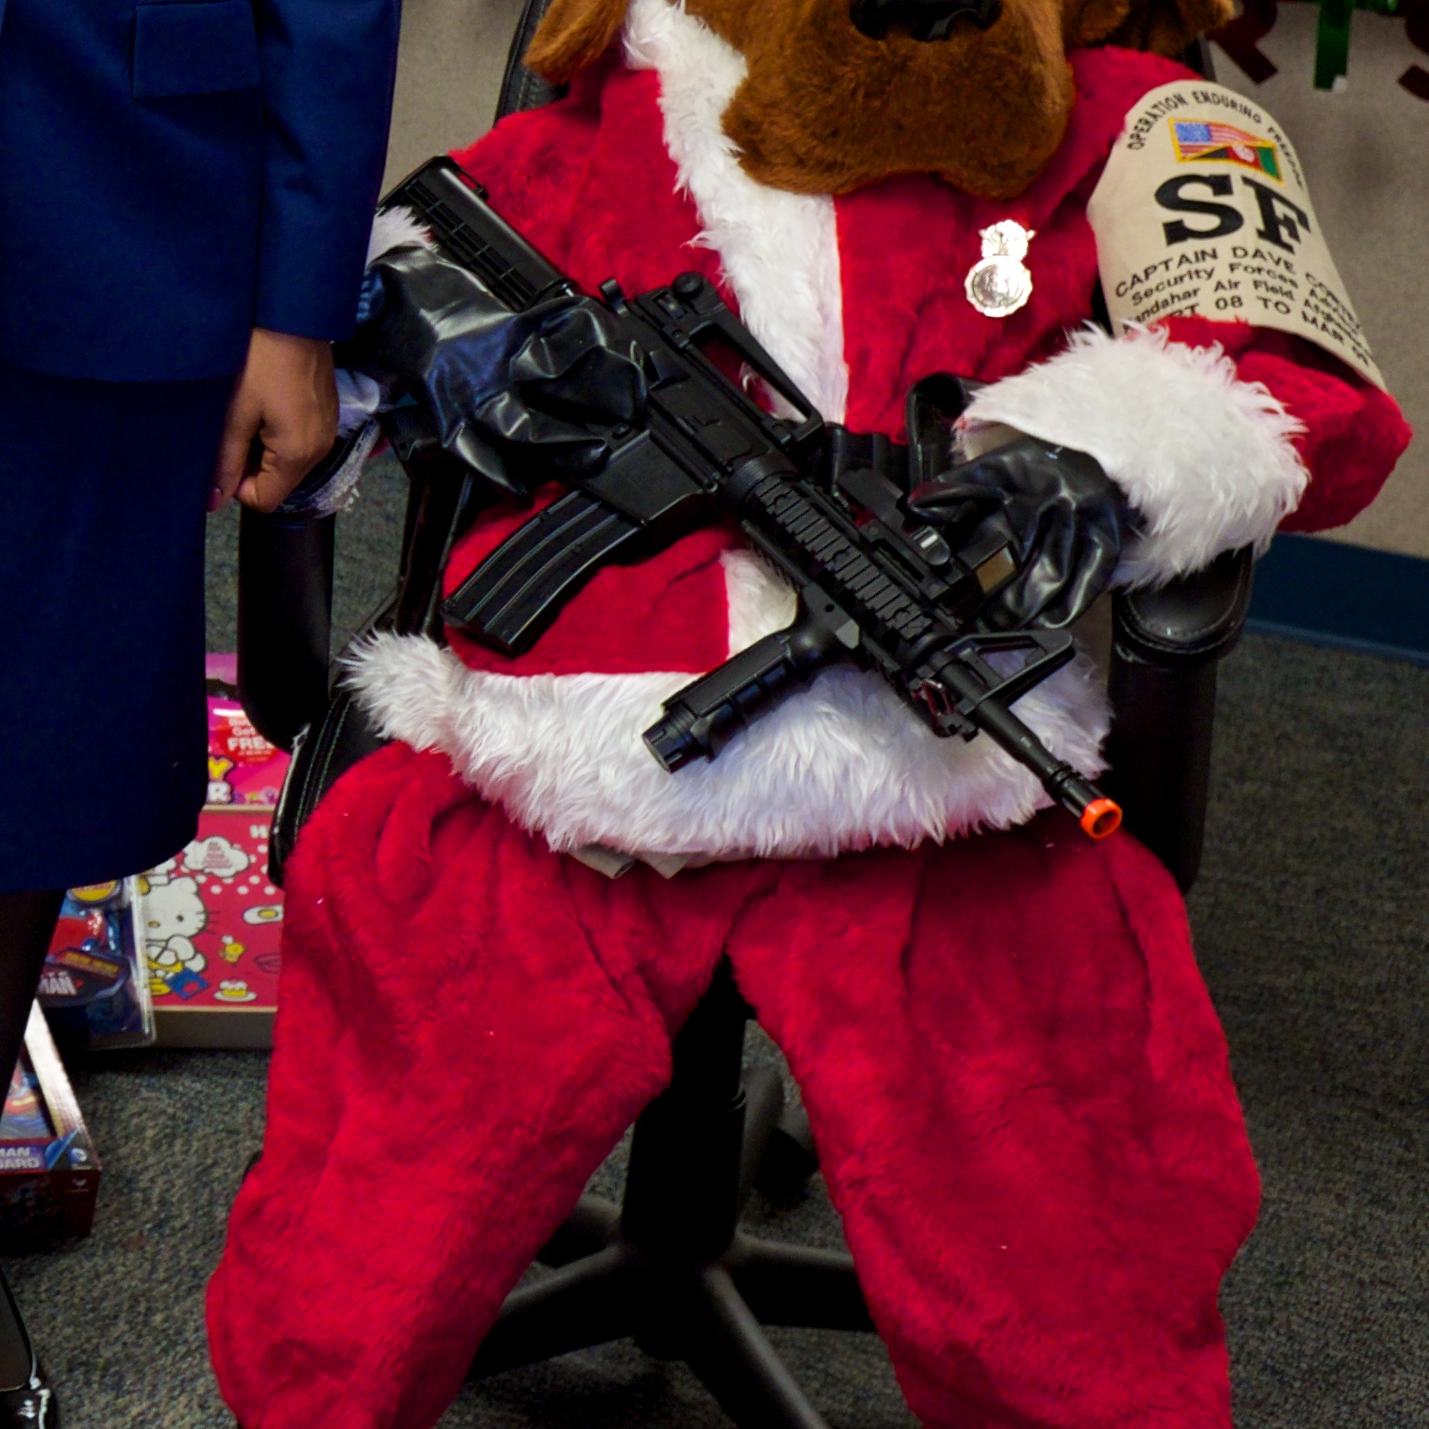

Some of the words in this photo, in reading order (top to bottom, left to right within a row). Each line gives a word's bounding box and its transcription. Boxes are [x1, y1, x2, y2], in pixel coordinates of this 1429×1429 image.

[1126, 91, 1190, 152] OPERATION
[1192, 89, 1263, 126] ENDURING
[1154, 173, 1311, 256] SF
[1115, 247, 1219, 300] CAPTAIN
[1231, 246, 1296, 275] DAVE
[1131, 266, 1216, 308] Security
[1229, 262, 1299, 290] Forces
[1214, 278, 1242, 294] Air
[1215, 296, 1243, 311] 08
[1257, 297, 1291, 316] TO
